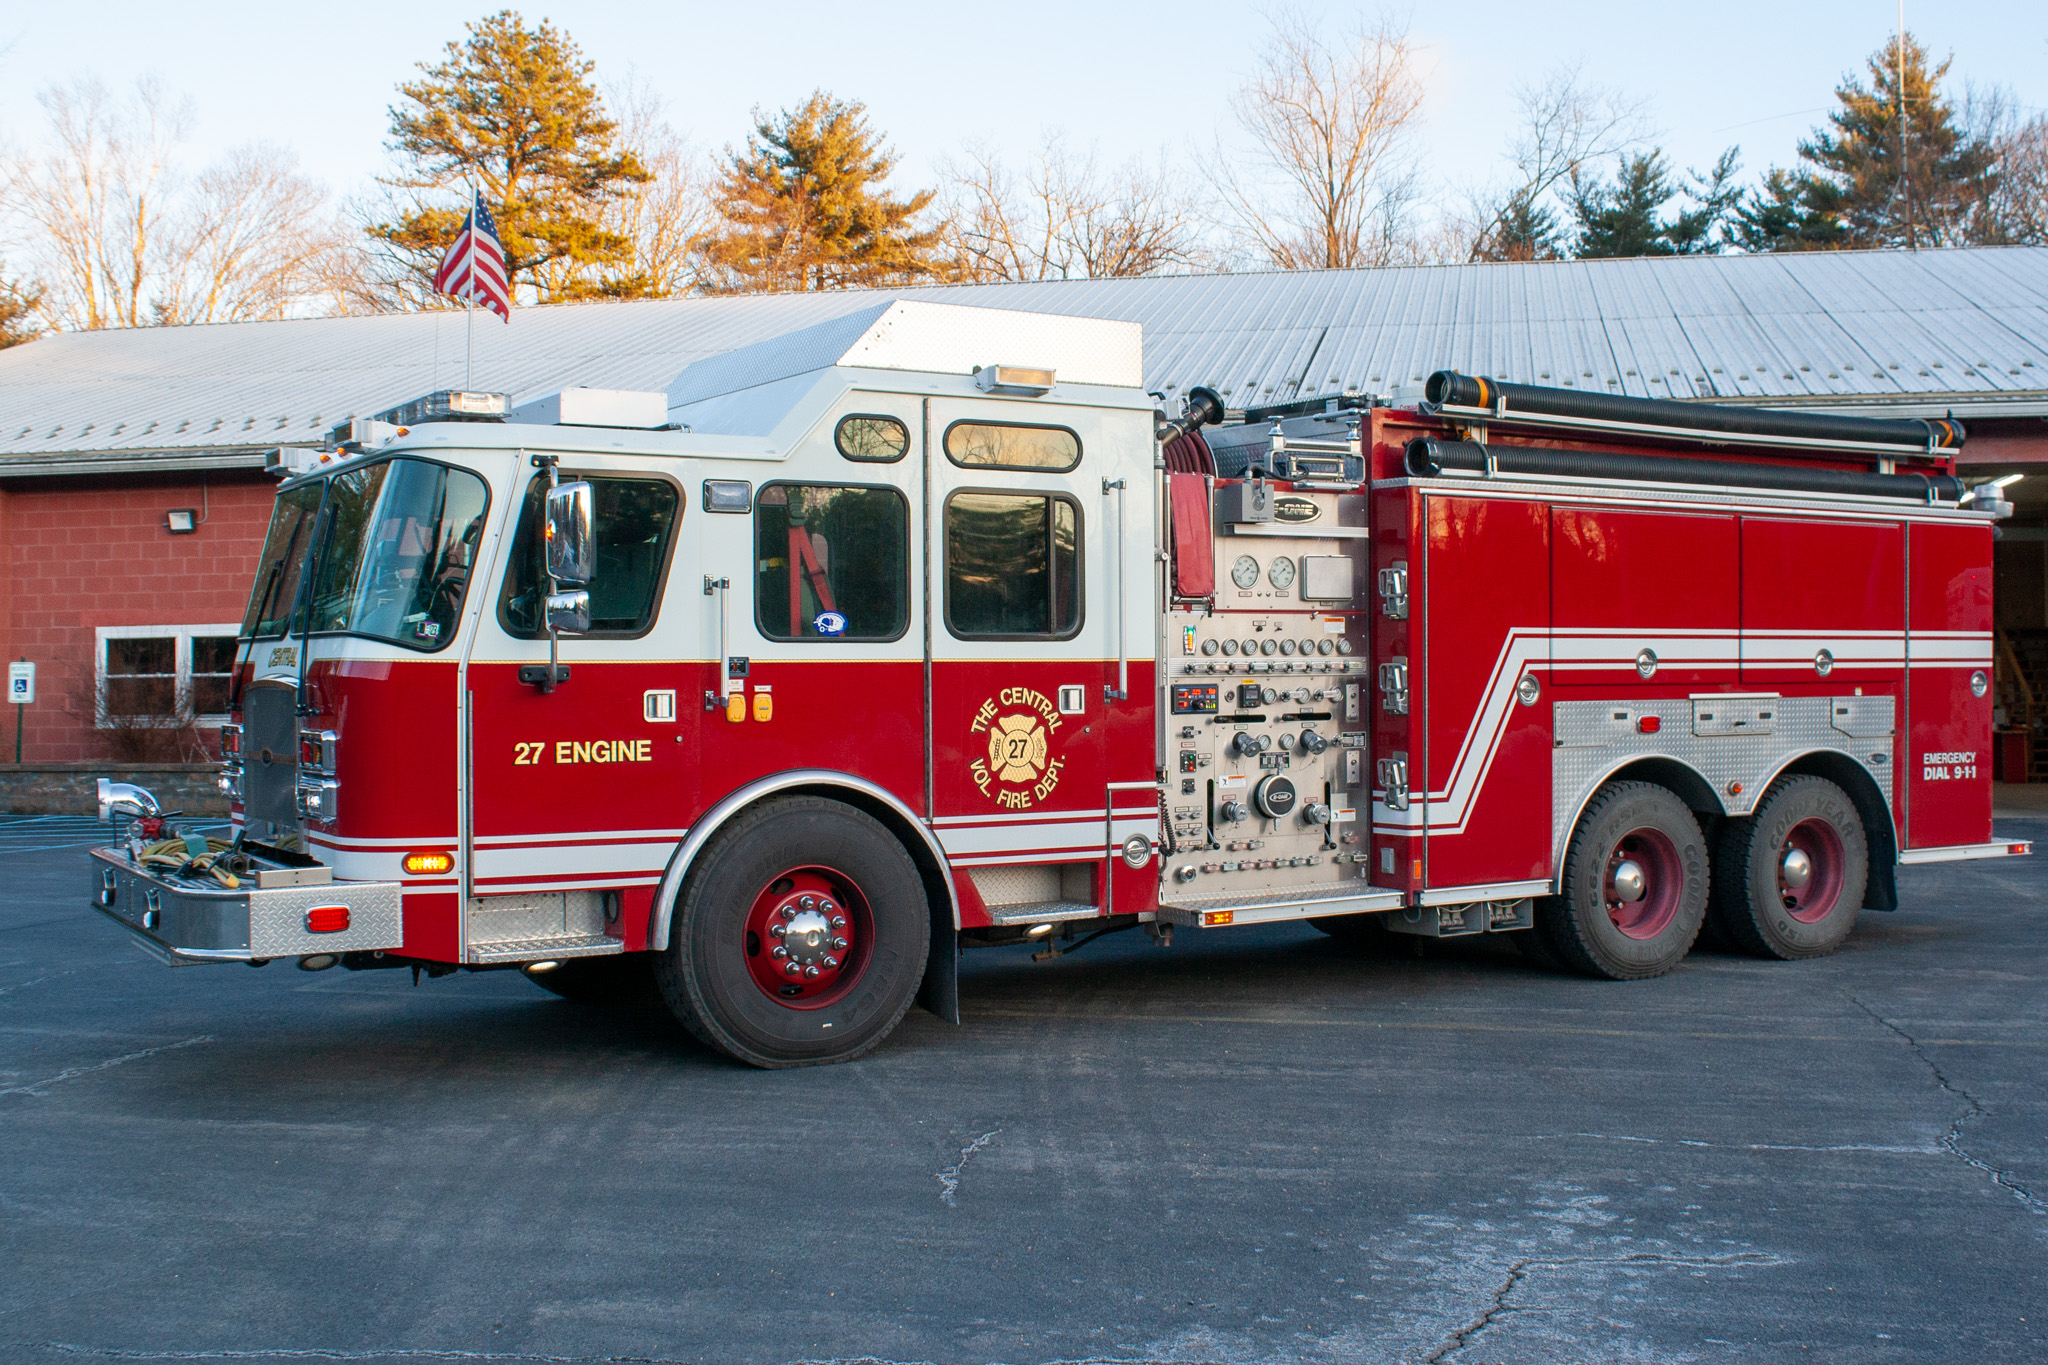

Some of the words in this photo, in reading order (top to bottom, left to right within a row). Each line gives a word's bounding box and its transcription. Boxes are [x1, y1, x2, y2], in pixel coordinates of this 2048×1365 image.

[970, 698, 999, 734] THE
[999, 687, 1063, 735] CENTRAL
[512, 742, 546, 766] 27
[554, 739, 653, 765] ENGINE
[1008, 739, 1028, 759] 27
[1923, 751, 1977, 765] EMERGENCY
[969, 757, 992, 798] VOL.
[994, 789, 1032, 809] FIRE
[1033, 754, 1066, 803] DEPT.
[1923, 766, 1951, 781] DIAL
[1953, 765, 1977, 779] 9-1-1
